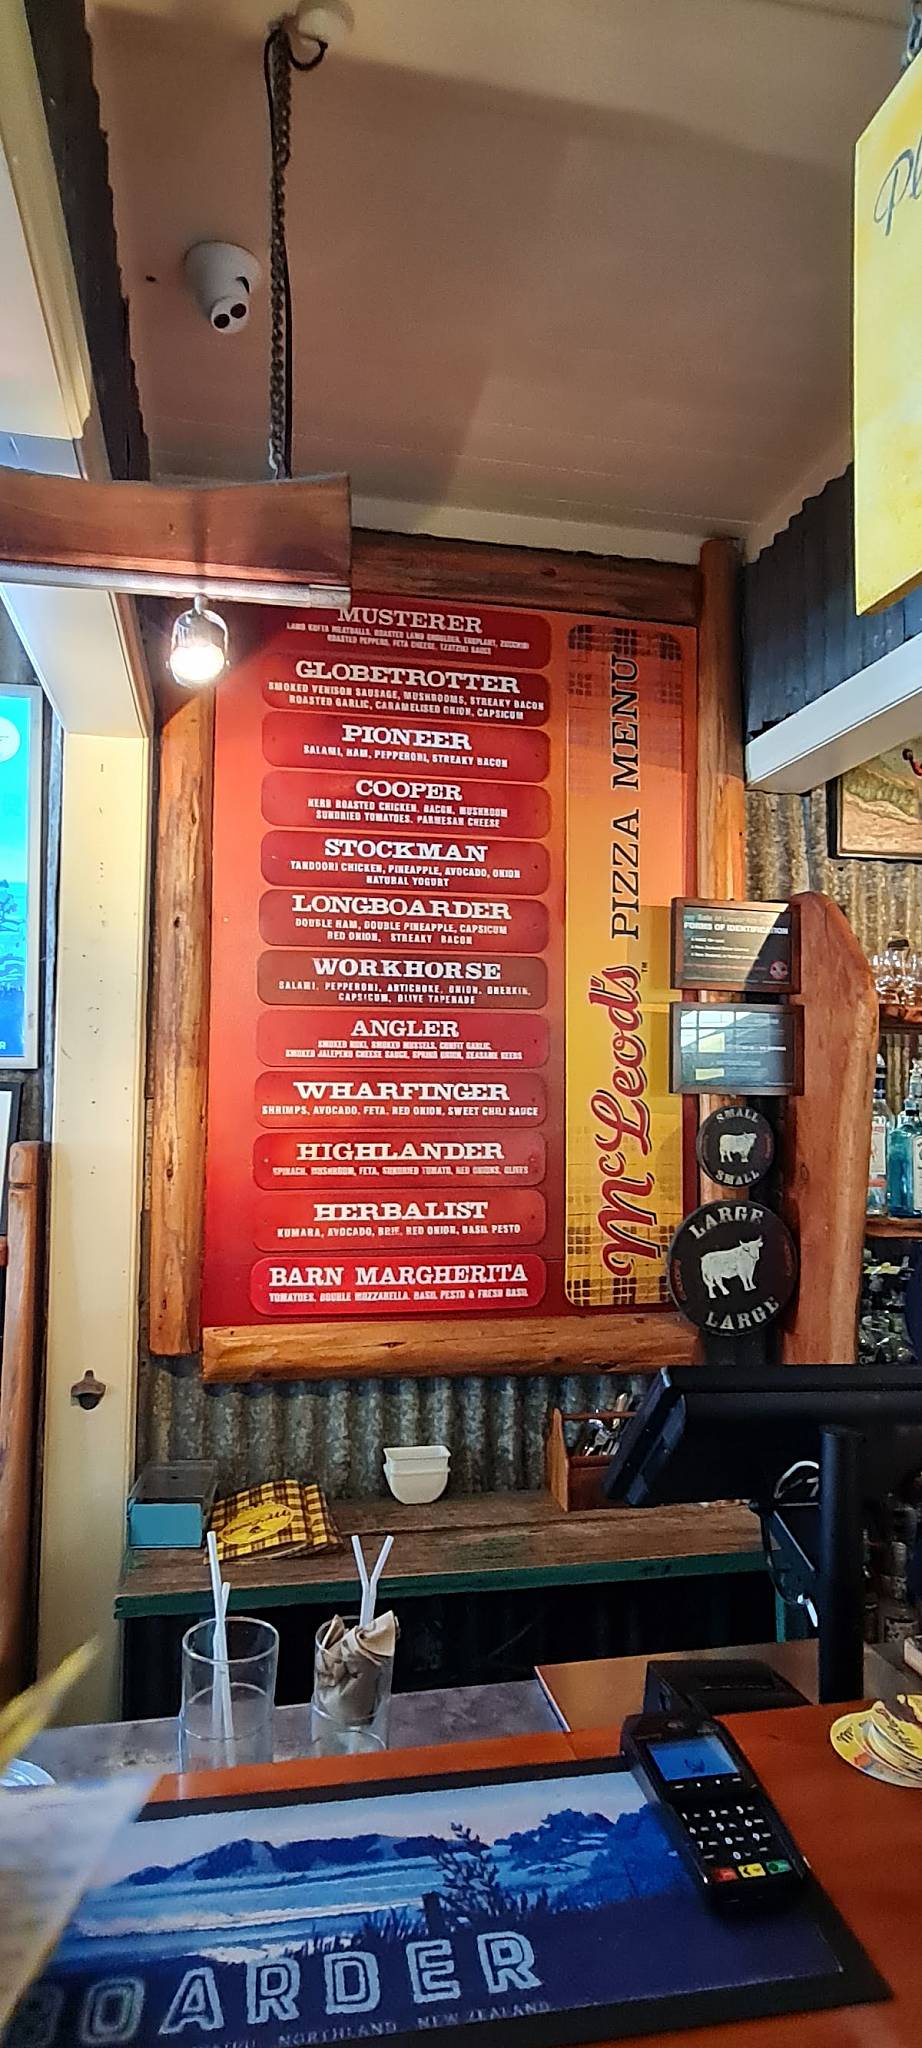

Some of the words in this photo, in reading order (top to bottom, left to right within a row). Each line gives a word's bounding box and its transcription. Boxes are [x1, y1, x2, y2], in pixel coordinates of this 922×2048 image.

[338, 607, 482, 633] MUSTERER
[295, 660, 520, 694] GLOBETROTTER
[268, 682, 308, 693] SMOKED
[312, 684, 352, 697] VENISON
[356, 687, 400, 700] SAUSAGE,
[404, 690, 468, 705] MUSHROOMS,
[470, 696, 511, 708] STREAKY
[514, 700, 544, 710] BACON
[289, 694, 332, 706] ROASTED
[335, 698, 374, 710] GARLIC,
[376, 701, 441, 714] CARAMELISED
[443, 705, 475, 718] ONION,
[477, 708, 524, 720] CAPSICUM
[609, 654, 641, 792] MENU
[342, 724, 472, 750] PIONEER
[304, 745, 344, 757] SALAMI,
[346, 748, 372, 759] HAM,
[374, 750, 430, 763] PEPPERONI,
[432, 754, 474, 765] STREAKY
[476, 756, 508, 768] BACON
[356, 780, 462, 800] COOPER
[325, 840, 488, 862] STOCKMAN
[290, 860, 338, 872] TANDOORI
[340, 862, 386, 874] CHICKEN,
[388, 864, 442, 876] PINEAPPLE,
[445, 866, 490, 878] AVOCADO,
[492, 868, 520, 878] ONION
[611, 809, 641, 940] PIZZA
[366, 876, 410, 886] NATURAL
[412, 878, 449, 887] YOGURT
[292, 895, 512, 920] LONGBOARDER
[296, 918, 332, 928] DOUBLE
[335, 920, 361, 930] HAM,
[364, 921, 401, 931] DOUBLE
[404, 922, 457, 934] PINEAPPLE,
[460, 924, 508, 934] CAPSICUM
[327, 931, 346, 940] RED
[348, 932, 381, 943] ONION,
[390, 933, 432, 944] STREAKY
[441, 935, 472, 944] BACON
[312, 958, 501, 980] WORKHORSE
[351, 1020, 459, 1038] ANGLER
[294, 1082, 510, 1101] WHARFINGER
[262, 1105, 310, 1116] SHRIMPS,
[312, 1106, 360, 1116] AVOCADO,
[364, 1106, 389, 1116] FETA,
[392, 1106, 410, 1116] RED
[413, 1106, 445, 1116] ONION,
[448, 1106, 479, 1116] SWEET
[508, 1106, 539, 1116] SAUCE
[589, 964, 662, 1277] McLeod's
[716, 1109, 760, 1124] SMALL
[296, 1144, 504, 1162] HIGHLANDER
[715, 1169, 760, 1185] SMALL
[314, 1202, 488, 1222] HERBALIST
[688, 1206, 764, 1240] LARGE
[276, 1228, 325, 1238] KUMARA,
[327, 1227, 374, 1237] AVOCADO,
[378, 1226, 402, 1237] BRIE,
[406, 1226, 424, 1236] RED
[426, 1225, 460, 1236] ONION,
[462, 1224, 488, 1234] BASIL
[491, 1224, 520, 1234] PESTO
[269, 1267, 344, 1287] BARN
[355, 1264, 528, 1286] MARGHERITA
[705, 1296, 780, 1330] LARGE
